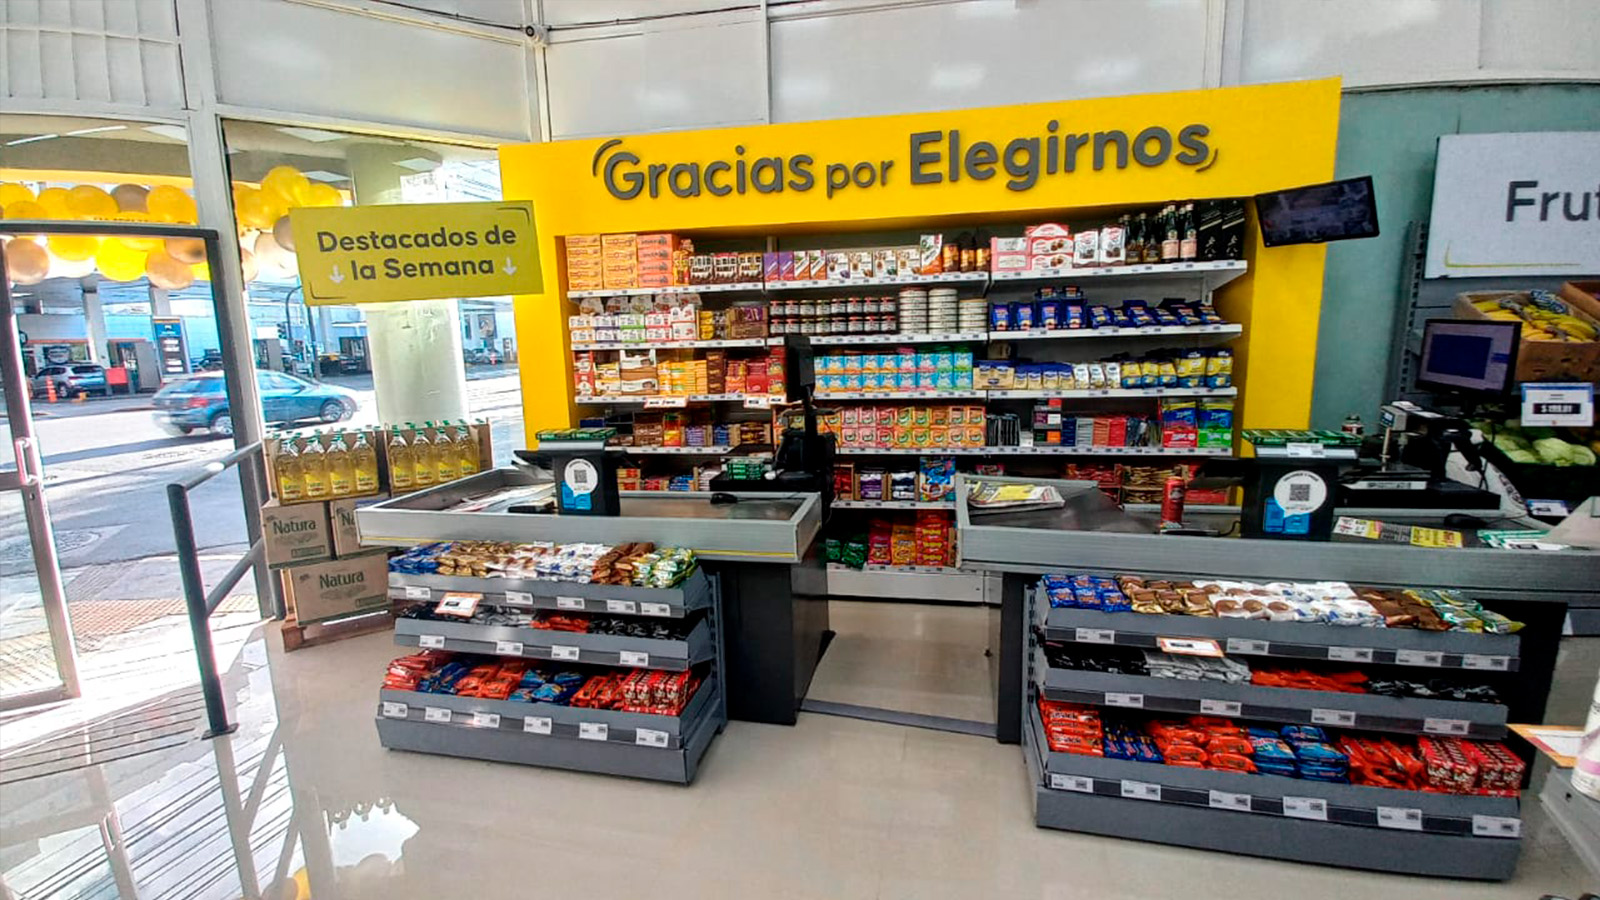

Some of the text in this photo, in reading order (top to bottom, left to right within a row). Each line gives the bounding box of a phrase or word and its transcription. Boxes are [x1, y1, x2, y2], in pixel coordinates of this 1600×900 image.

[603, 119, 1211, 200] Gracias por Elegirnos
[316, 225, 517, 253] Destacados de
[351, 258, 494, 281] la Semana
[272, 519, 317, 535] Natura
[319, 570, 365, 590] Natura
